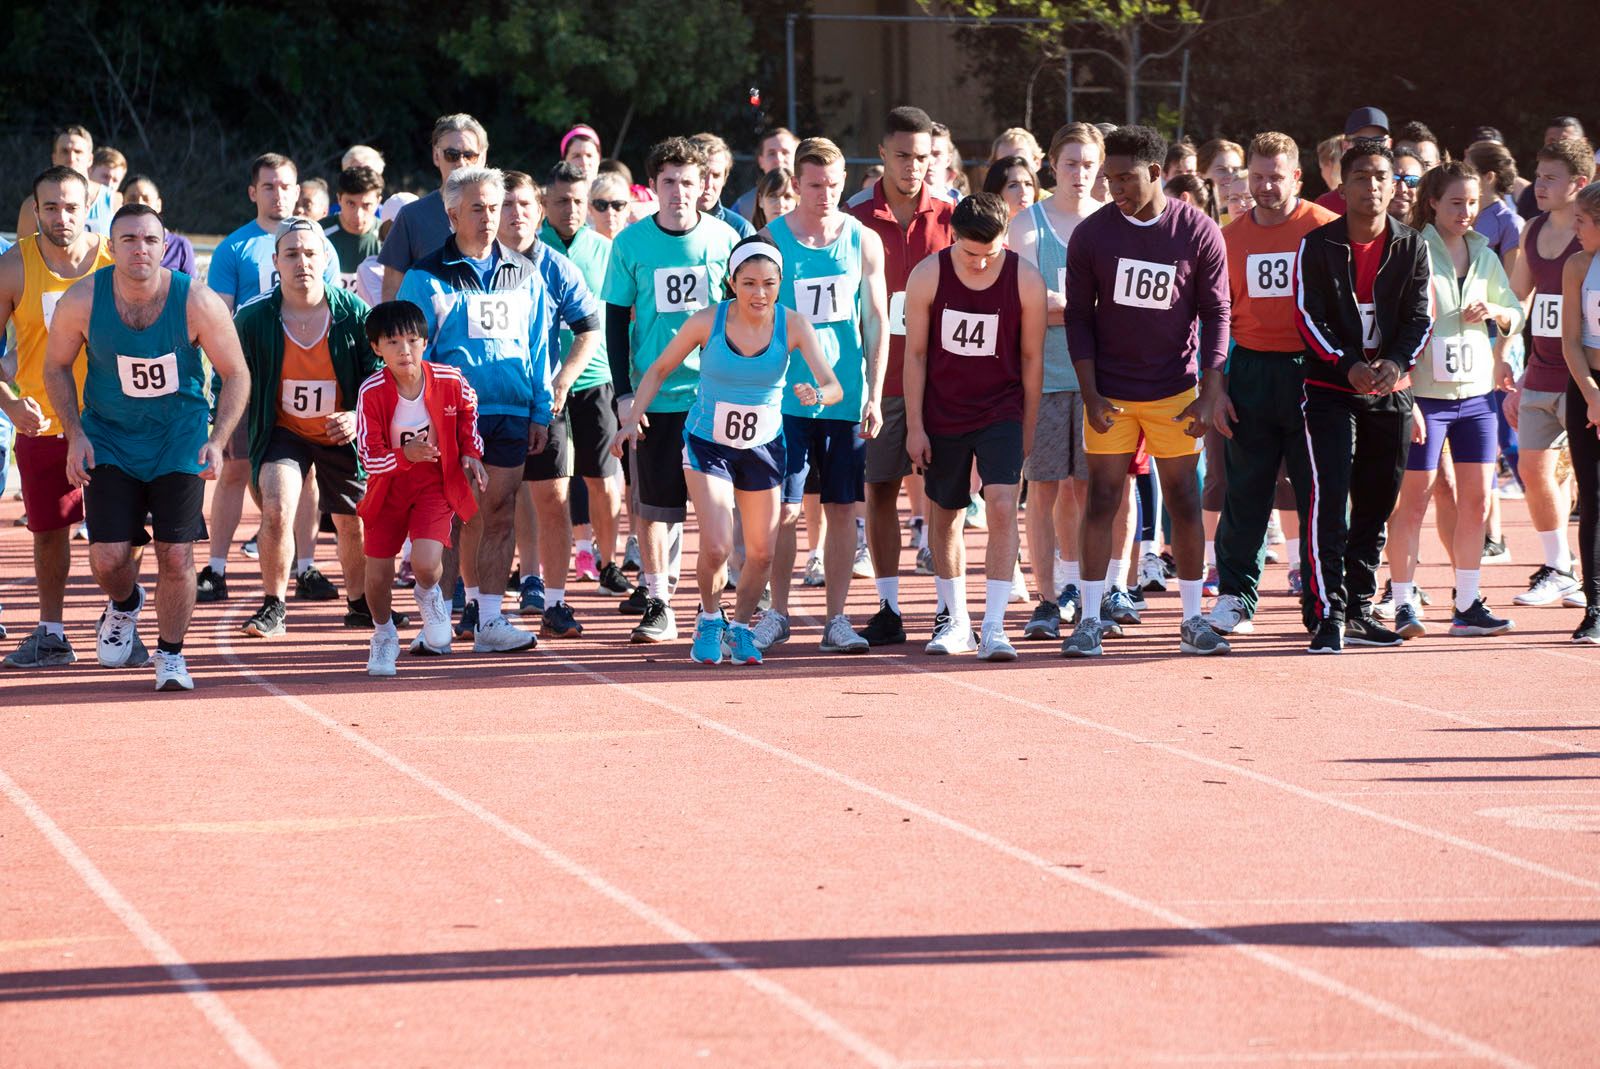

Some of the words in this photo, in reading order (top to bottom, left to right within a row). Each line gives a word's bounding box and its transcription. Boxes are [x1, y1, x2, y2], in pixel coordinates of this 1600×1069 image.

[666, 273, 697, 304] 82
[1124, 266, 1170, 302] 168
[1258, 258, 1289, 290] 83
[806, 282, 838, 316] 71
[479, 300, 509, 331] 53
[1360, 310, 1376, 341] 7
[1539, 300, 1559, 330] 15
[952, 319, 985, 348] 44
[1445, 343, 1473, 374] 50
[131, 362, 166, 390] 59
[293, 385, 323, 412] 51
[725, 410, 758, 442] 68
